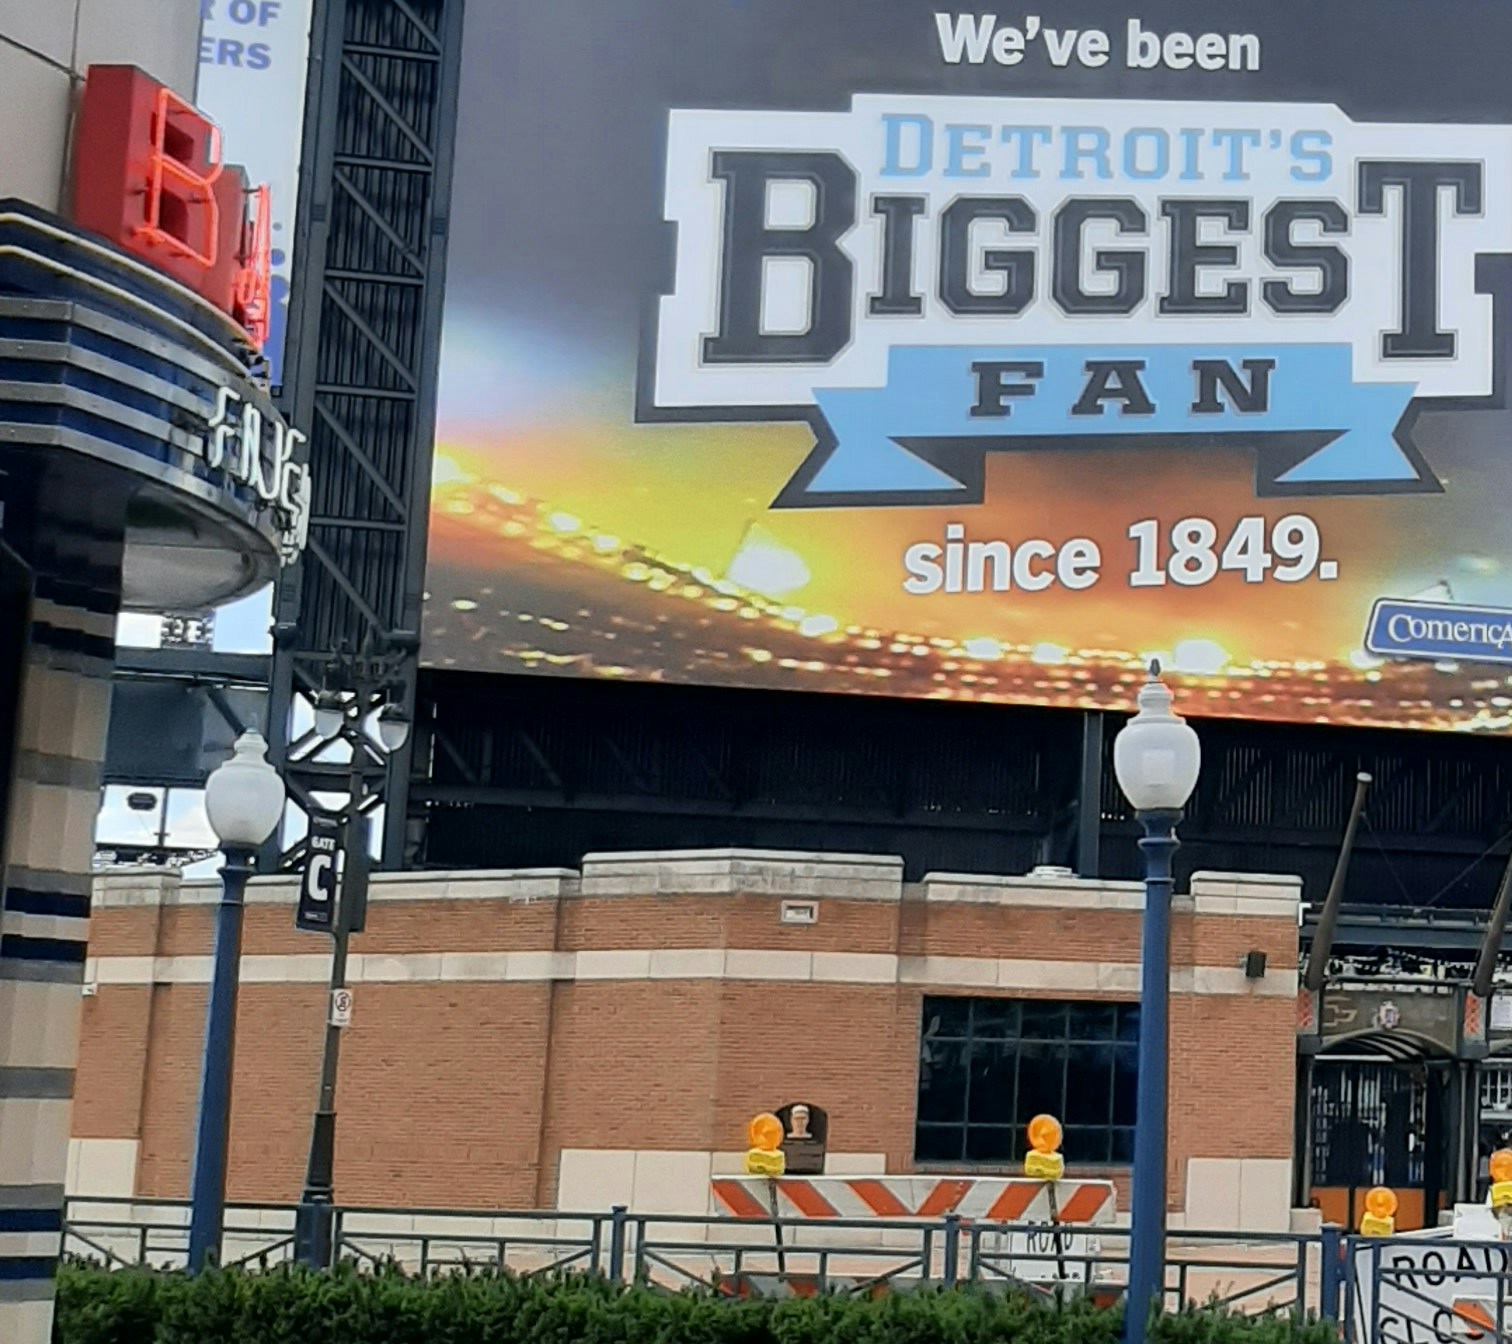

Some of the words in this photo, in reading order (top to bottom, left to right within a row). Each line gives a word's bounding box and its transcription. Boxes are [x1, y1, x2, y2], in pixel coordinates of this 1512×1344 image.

[935, 12, 1109, 68] We've
[1126, 18, 1261, 72] been
[880, 112, 1335, 183] DETROIT'S
[697, 146, 1486, 368] BIGGEST
[967, 356, 1276, 419] FAN
[904, 523, 1101, 596] since
[1128, 514, 1339, 588] 1849.
[311, 836, 336, 852] GATE
[308, 854, 332, 902] C
